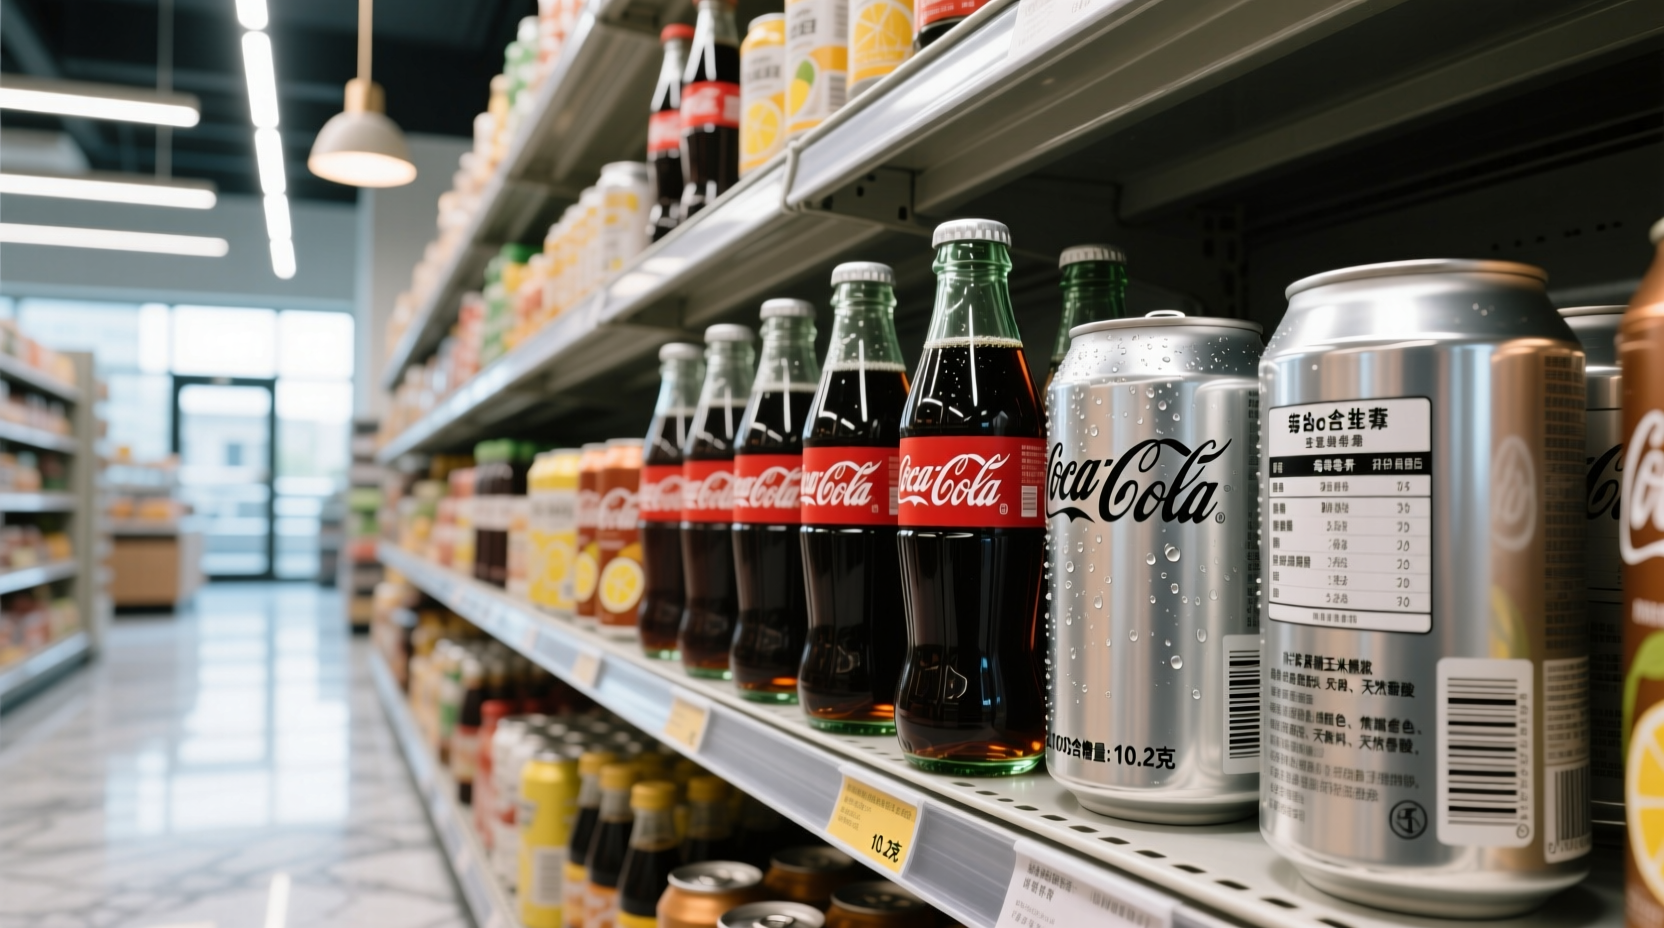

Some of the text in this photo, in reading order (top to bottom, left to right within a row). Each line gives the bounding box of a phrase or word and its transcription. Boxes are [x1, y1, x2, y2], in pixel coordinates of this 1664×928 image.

[898, 453, 1011, 507] Coca-Cola
[1046, 438, 1232, 524] Coca-Cola
[1114, 744, 1176, 770] 10.2克
